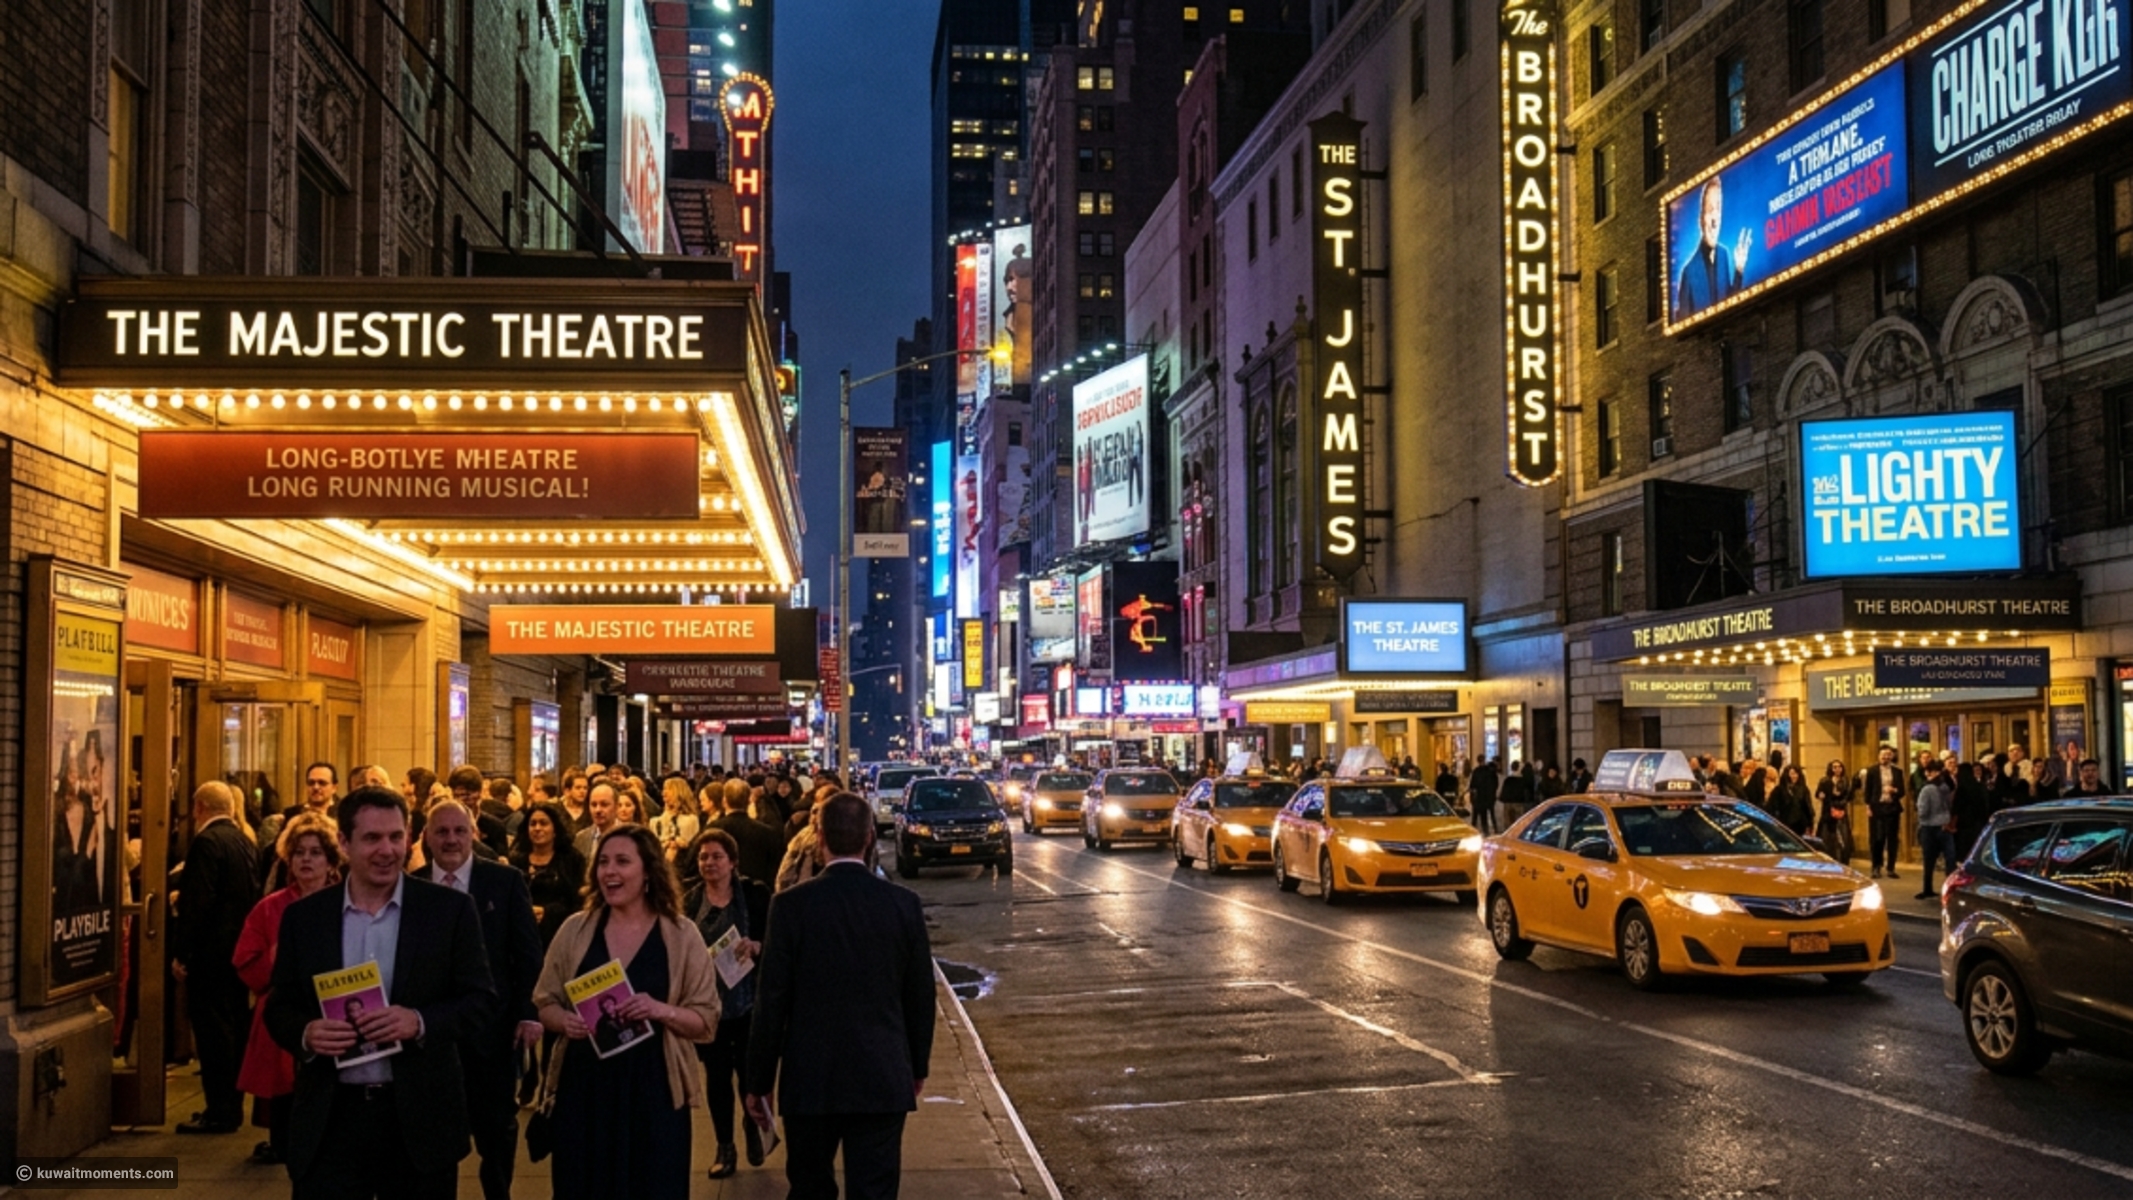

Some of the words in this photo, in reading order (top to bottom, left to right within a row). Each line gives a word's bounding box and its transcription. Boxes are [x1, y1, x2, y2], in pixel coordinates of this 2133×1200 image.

[1507, 9, 1549, 35] The
[1932, 0, 2046, 154] CHARGE
[1319, 144, 1356, 164] THE
[1515, 50, 1548, 465] BROADHURST
[107, 310, 200, 355] THE
[229, 311, 466, 358] MAJESTIC
[492, 313, 704, 359] THEATRE
[1323, 309, 1359, 555] JAMES
[266, 448, 445, 469] LONG-BOTLYE
[248, 476, 319, 498] LONG
[328, 477, 451, 498] RUNNING
[460, 477, 589, 498] MUSICAL!
[1840, 446, 2003, 505] LIGHTY
[1813, 500, 2010, 544] THEATRE
[1854, 599, 1886, 615] THE
[1890, 599, 1997, 615] BROADHURST
[2001, 600, 2070, 615] THEATRE
[506, 621, 548, 639] THE
[554, 621, 656, 639] MAJESTIC
[662, 620, 755, 638] THEATRE
[1353, 621, 1383, 634] THE
[1386, 621, 1406, 634] ST.
[1411, 621, 1459, 635] JAMES
[1723, 607, 1773, 636] THEATRE
[1373, 638, 1440, 652] THEATRE
[1882, 654, 1907, 667] THE
[1991, 654, 2042, 667] THEATRE
[1823, 675, 1852, 700] THE
